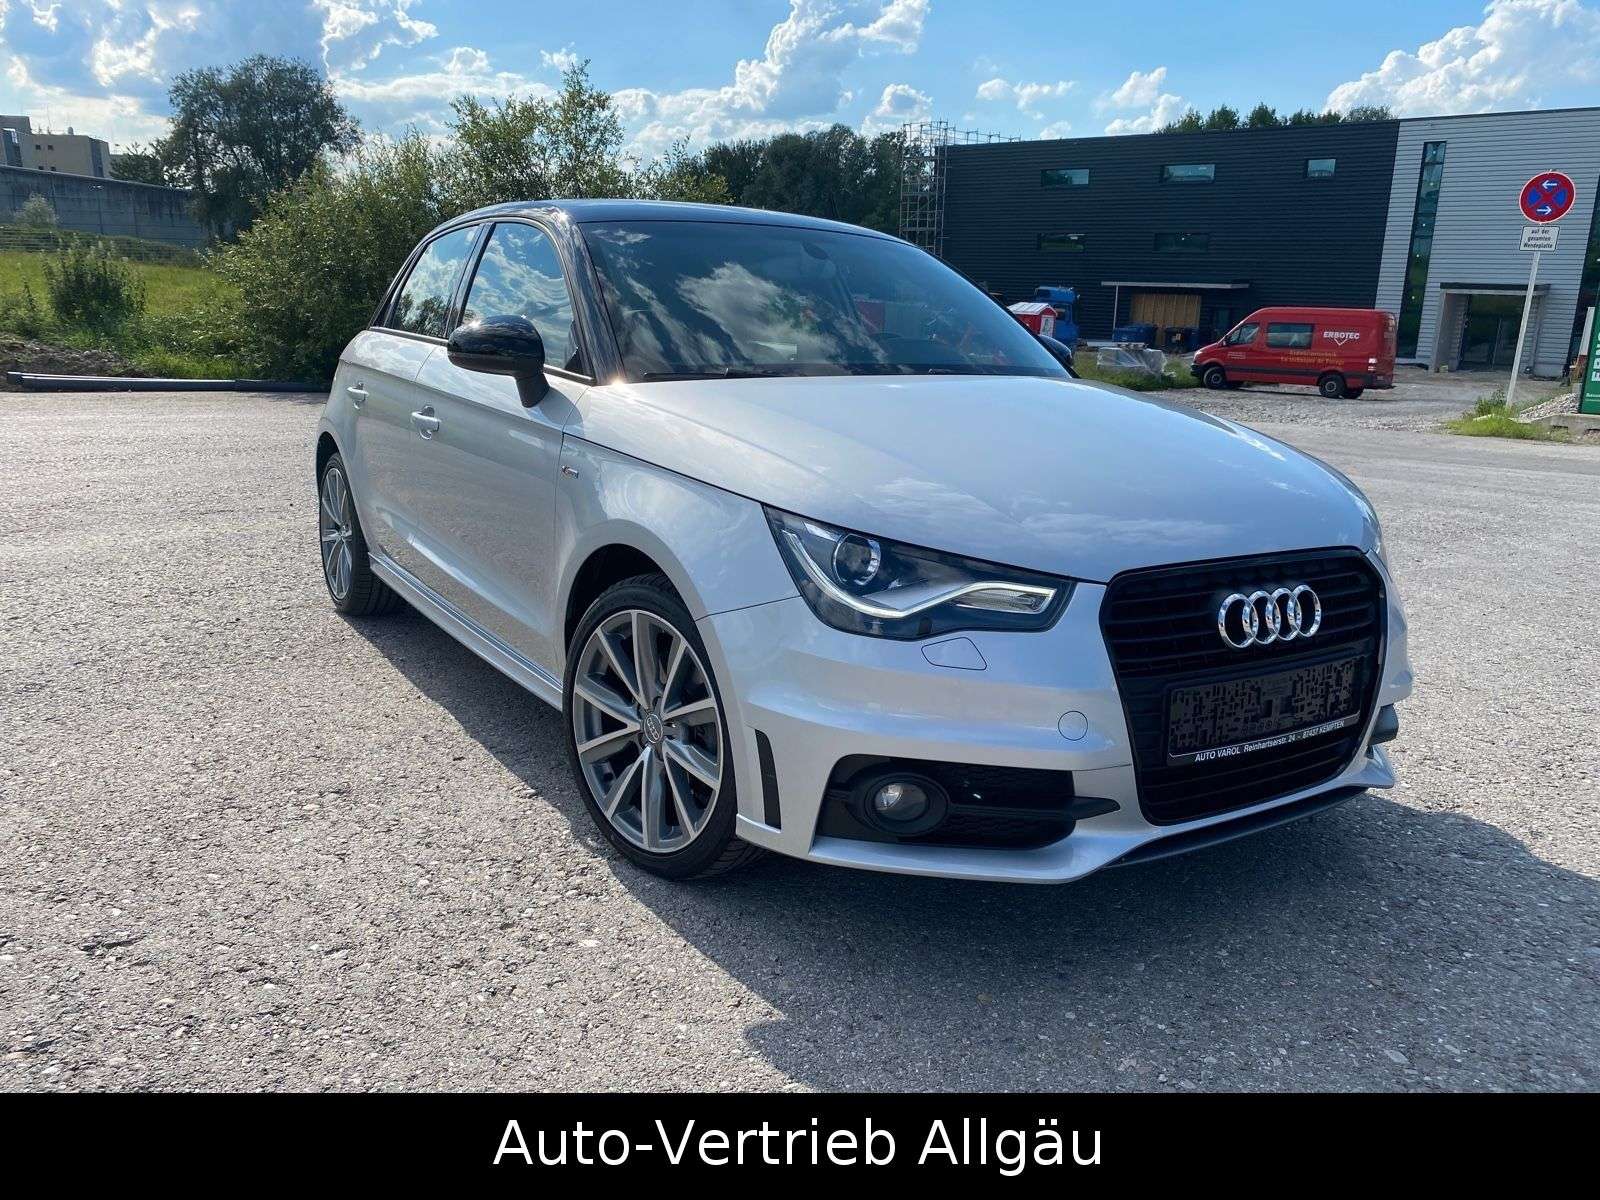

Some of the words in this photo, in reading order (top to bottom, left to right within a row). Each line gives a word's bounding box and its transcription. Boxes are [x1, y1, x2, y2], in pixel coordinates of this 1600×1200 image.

[1323, 331, 1360, 339] ERBOTEC
[1195, 750, 1216, 762] AUTO
[1217, 746, 1241, 758] VAROL
[1288, 734, 1296, 743] 24
[1319, 721, 1344, 734] KEMPTEN
